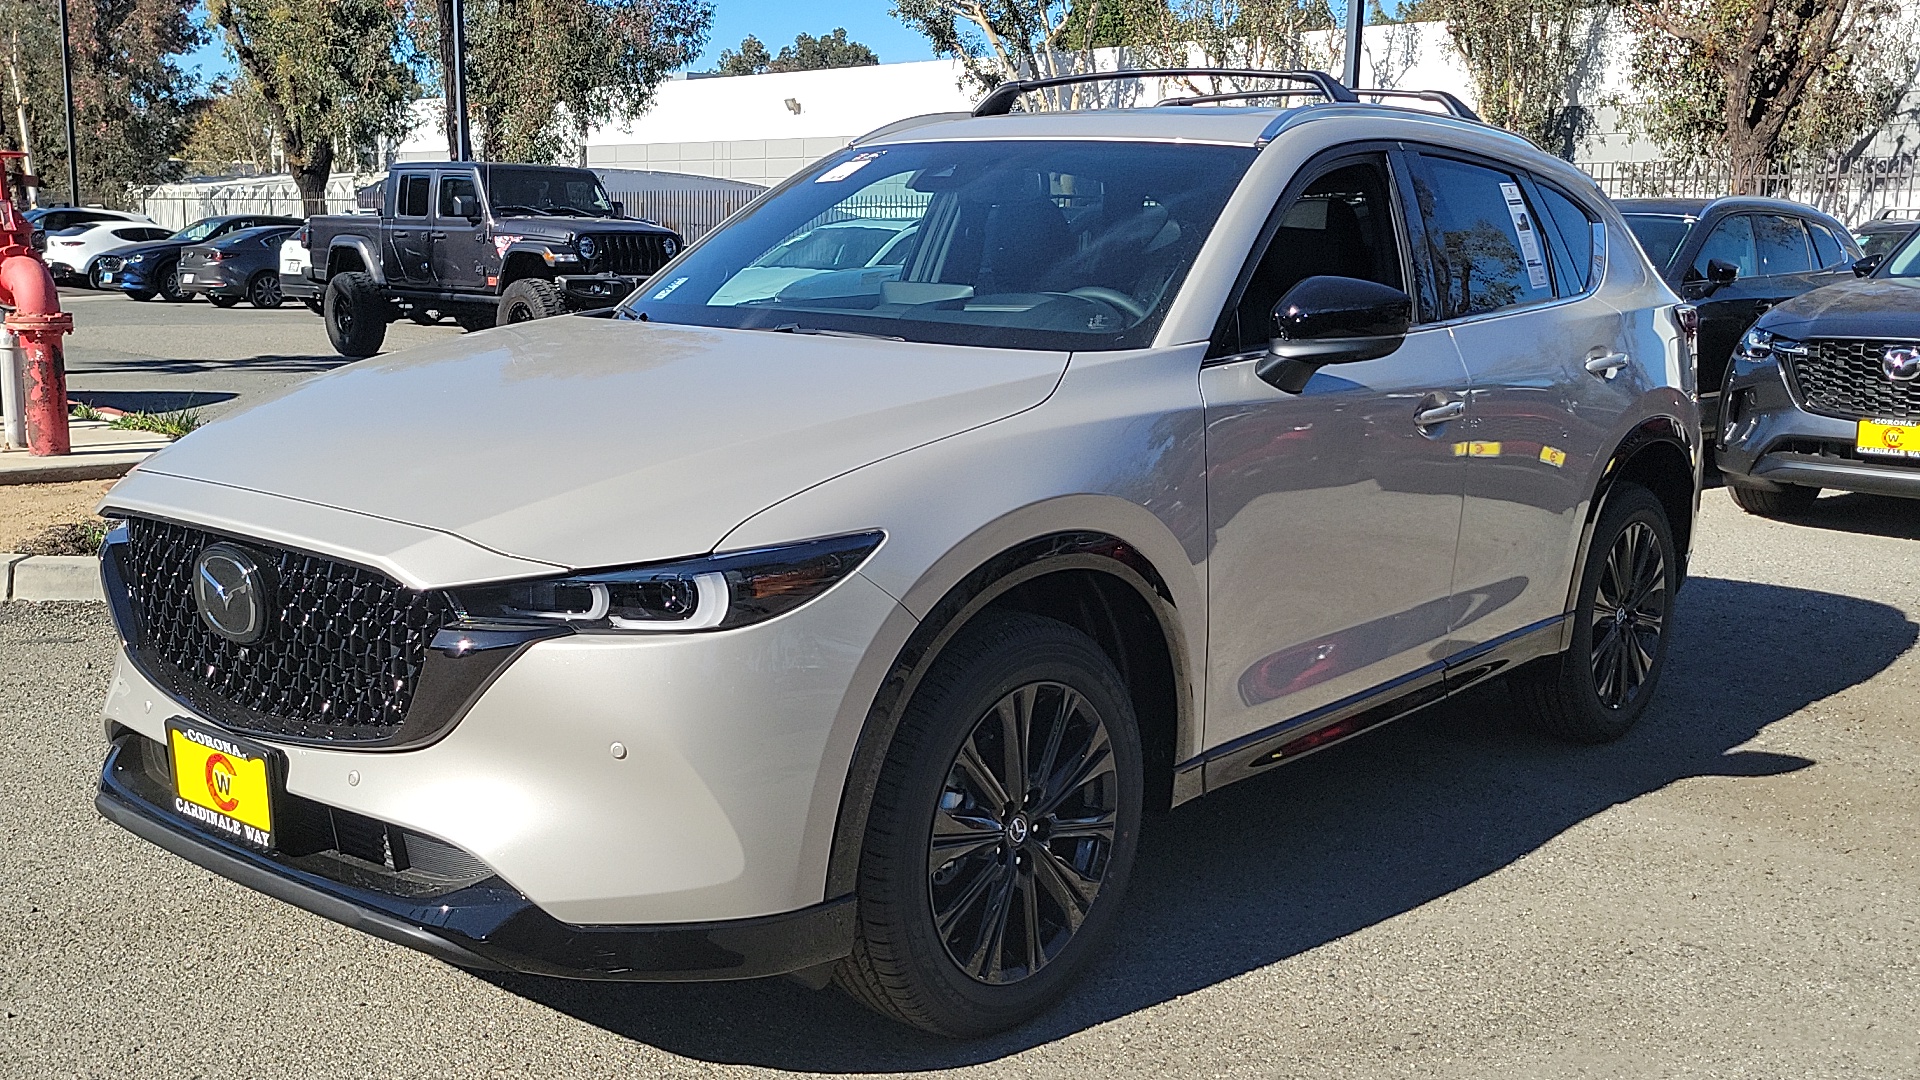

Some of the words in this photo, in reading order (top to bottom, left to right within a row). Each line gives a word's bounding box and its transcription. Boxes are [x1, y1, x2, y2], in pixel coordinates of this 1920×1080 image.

[1874, 418, 1914, 427] CORONA
[1881, 426, 1905, 449] C
[1888, 434, 1900, 443] W
[1856, 446, 1906, 457] CARDINALE
[1907, 450, 1920, 458] WA
[187, 729, 241, 757] CORONA
[205, 753, 239, 812] C
[214, 769, 232, 796] W
[175, 798, 242, 836] CARDINALE
[244, 825, 271, 847] WAY
